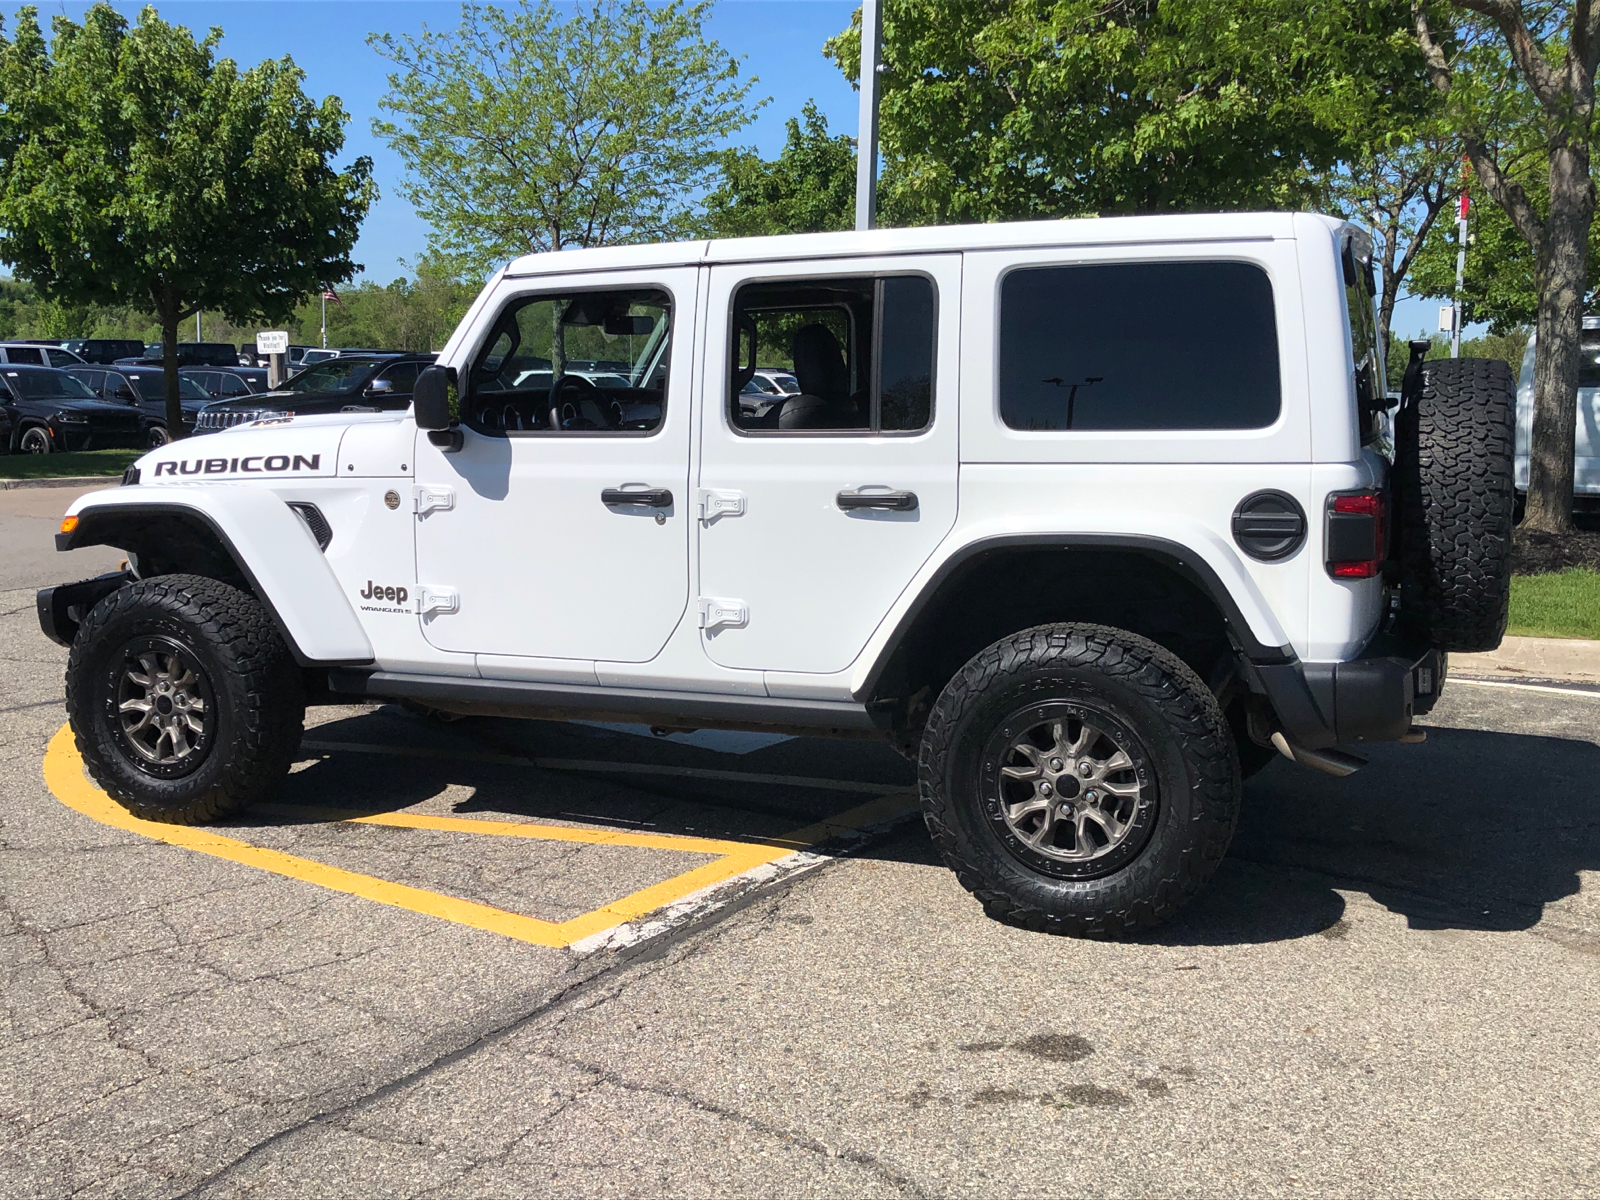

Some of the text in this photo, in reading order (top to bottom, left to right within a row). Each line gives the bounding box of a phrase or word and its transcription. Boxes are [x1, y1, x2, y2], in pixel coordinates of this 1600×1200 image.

[154, 454, 321, 477] RUBICON
[360, 579, 408, 605] Jeep
[360, 605, 404, 613] WRANGLER
